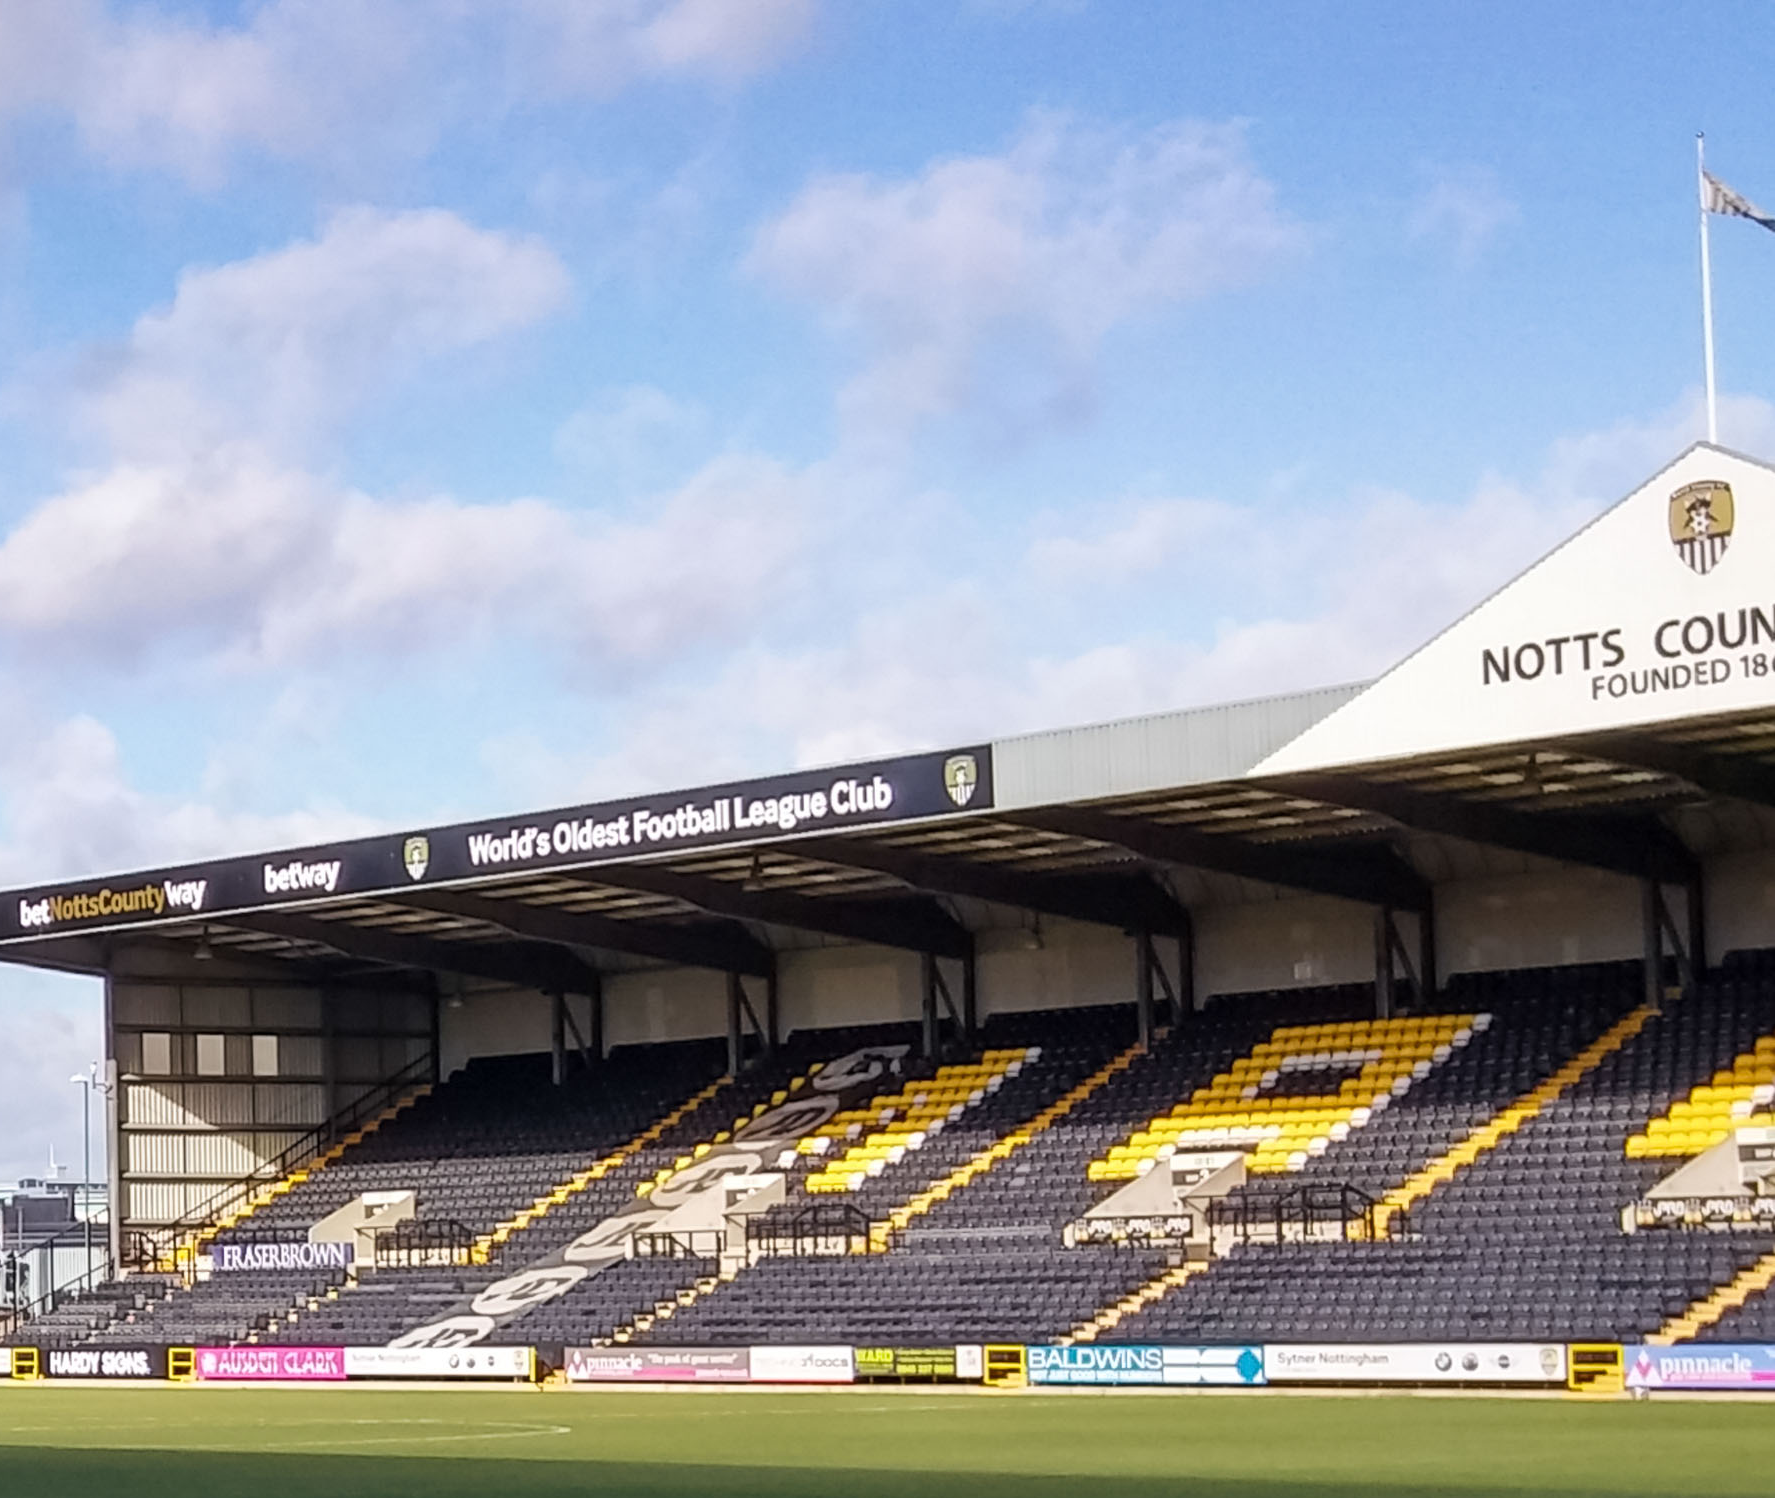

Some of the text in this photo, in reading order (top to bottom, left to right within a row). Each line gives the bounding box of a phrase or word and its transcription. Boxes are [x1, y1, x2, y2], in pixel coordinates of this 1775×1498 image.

[1482, 628, 1626, 686] NOTTS
[1592, 658, 1731, 701] FOUNDED
[468, 774, 894, 867] World's Oldest Football League Club
[264, 858, 342, 893] betway
[50, 1351, 100, 1375] HARDY
[586, 1353, 643, 1371] pinnacle
[1029, 1347, 1163, 1370] BALDWINS
[1278, 1353, 1389, 1366] Sytner Nottingham
[1660, 1352, 1752, 1379] pinnacle
